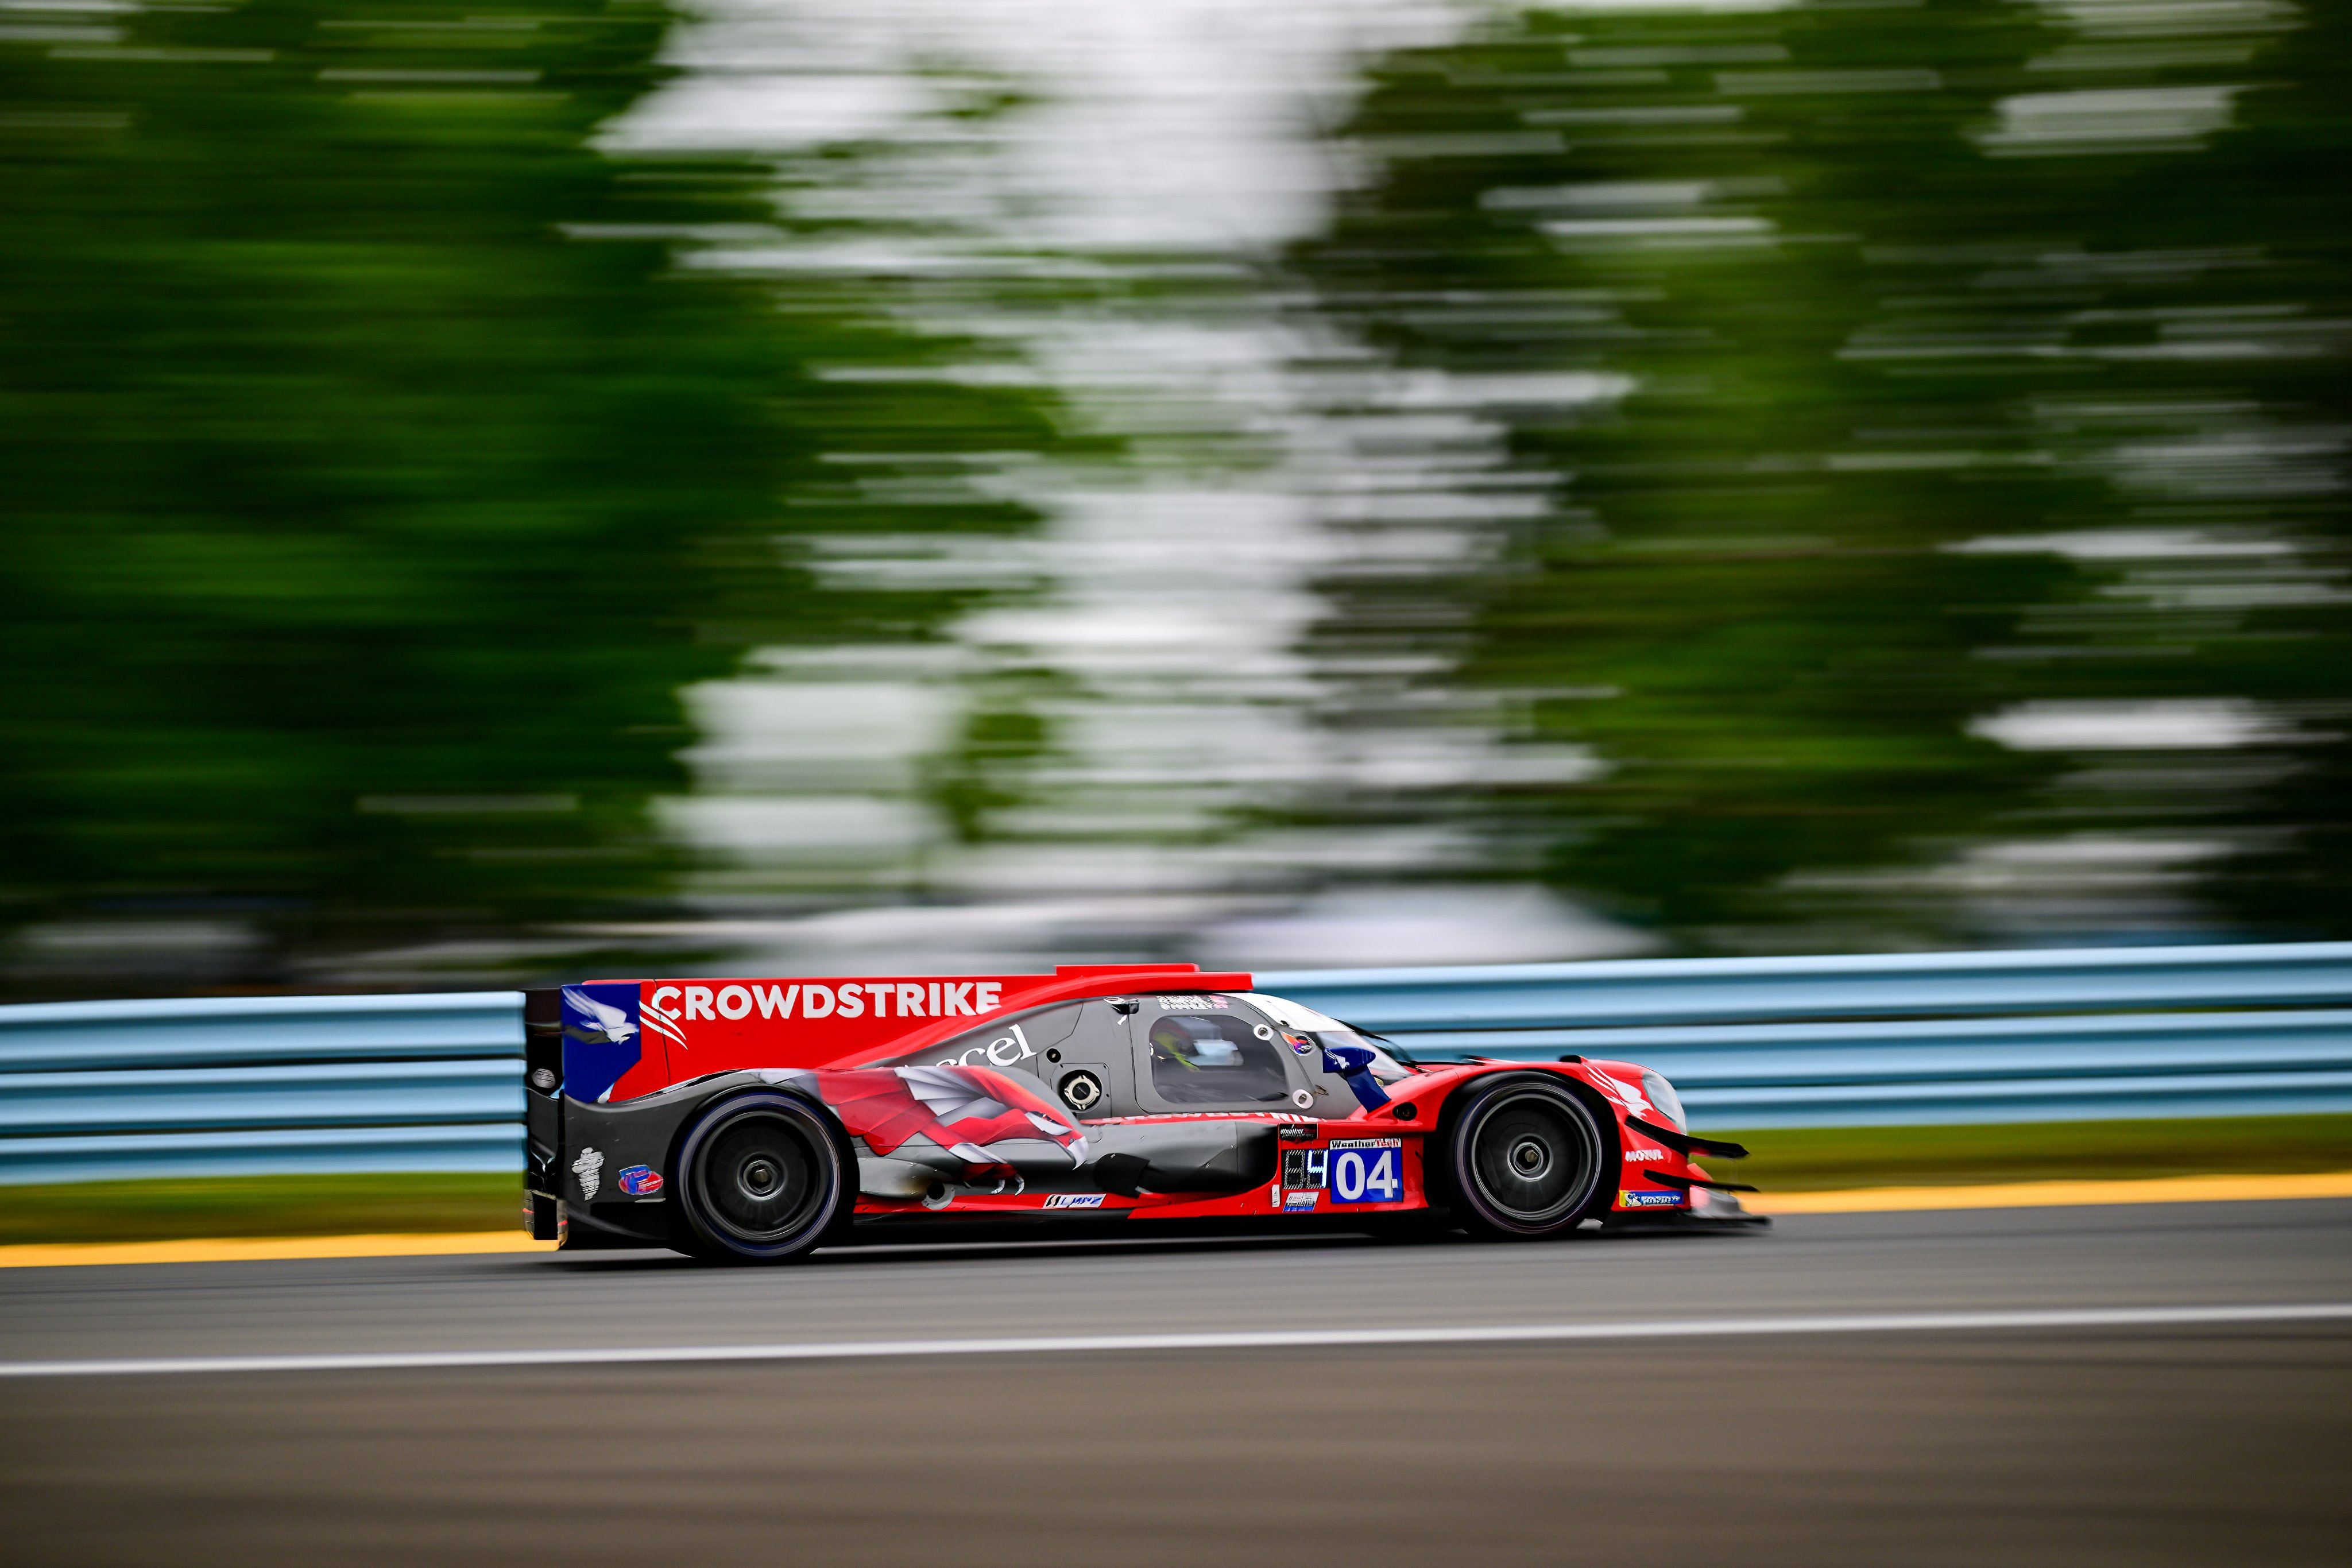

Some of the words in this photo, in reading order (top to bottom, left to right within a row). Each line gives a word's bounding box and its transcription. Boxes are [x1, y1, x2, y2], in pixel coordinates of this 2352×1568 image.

[652, 982, 1003, 1020] CROWDSTRIKE
[1332, 1139, 1399, 1148] WeatherTech
[1336, 1151, 1398, 1200] 04
